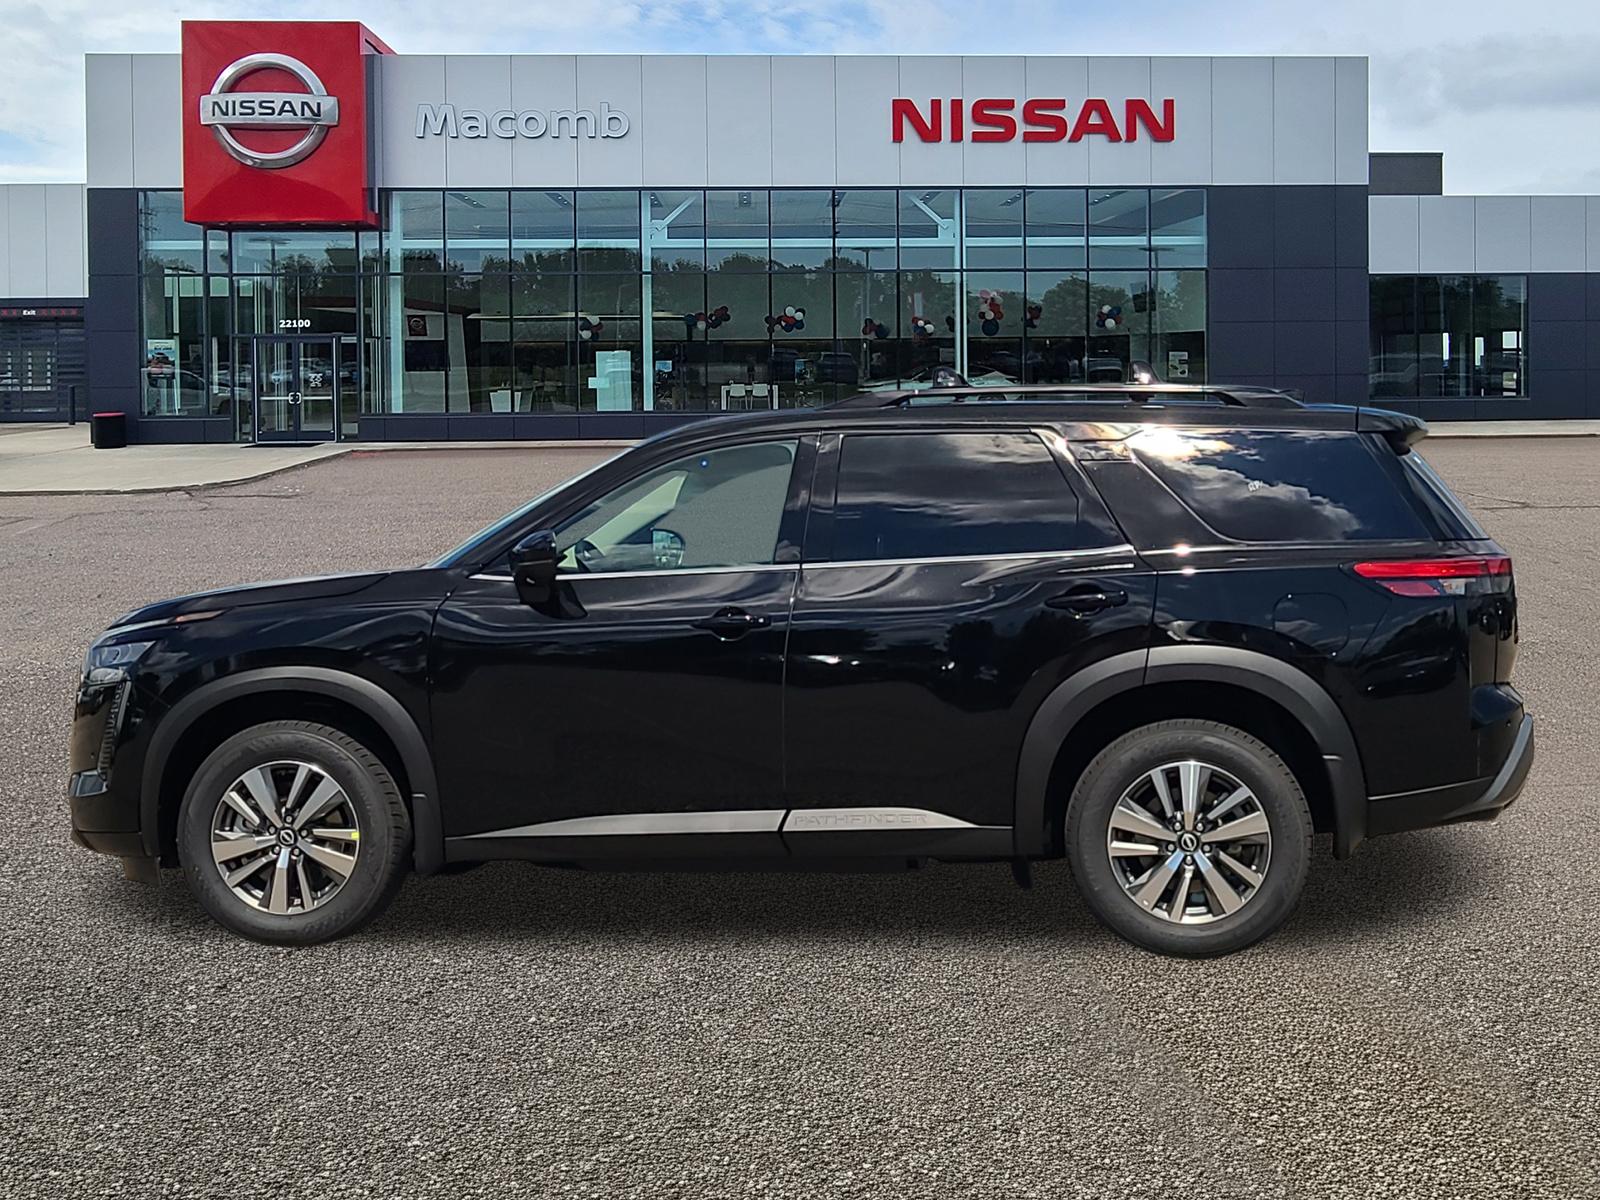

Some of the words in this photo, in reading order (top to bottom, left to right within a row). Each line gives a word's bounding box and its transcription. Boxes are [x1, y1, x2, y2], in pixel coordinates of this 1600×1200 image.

[211, 99, 322, 118] NISSAN
[415, 102, 630, 140] Macomb
[891, 98, 1175, 143] NISSAN
[279, 319, 311, 328] 22100
[793, 813, 928, 827] PATHFINDER
